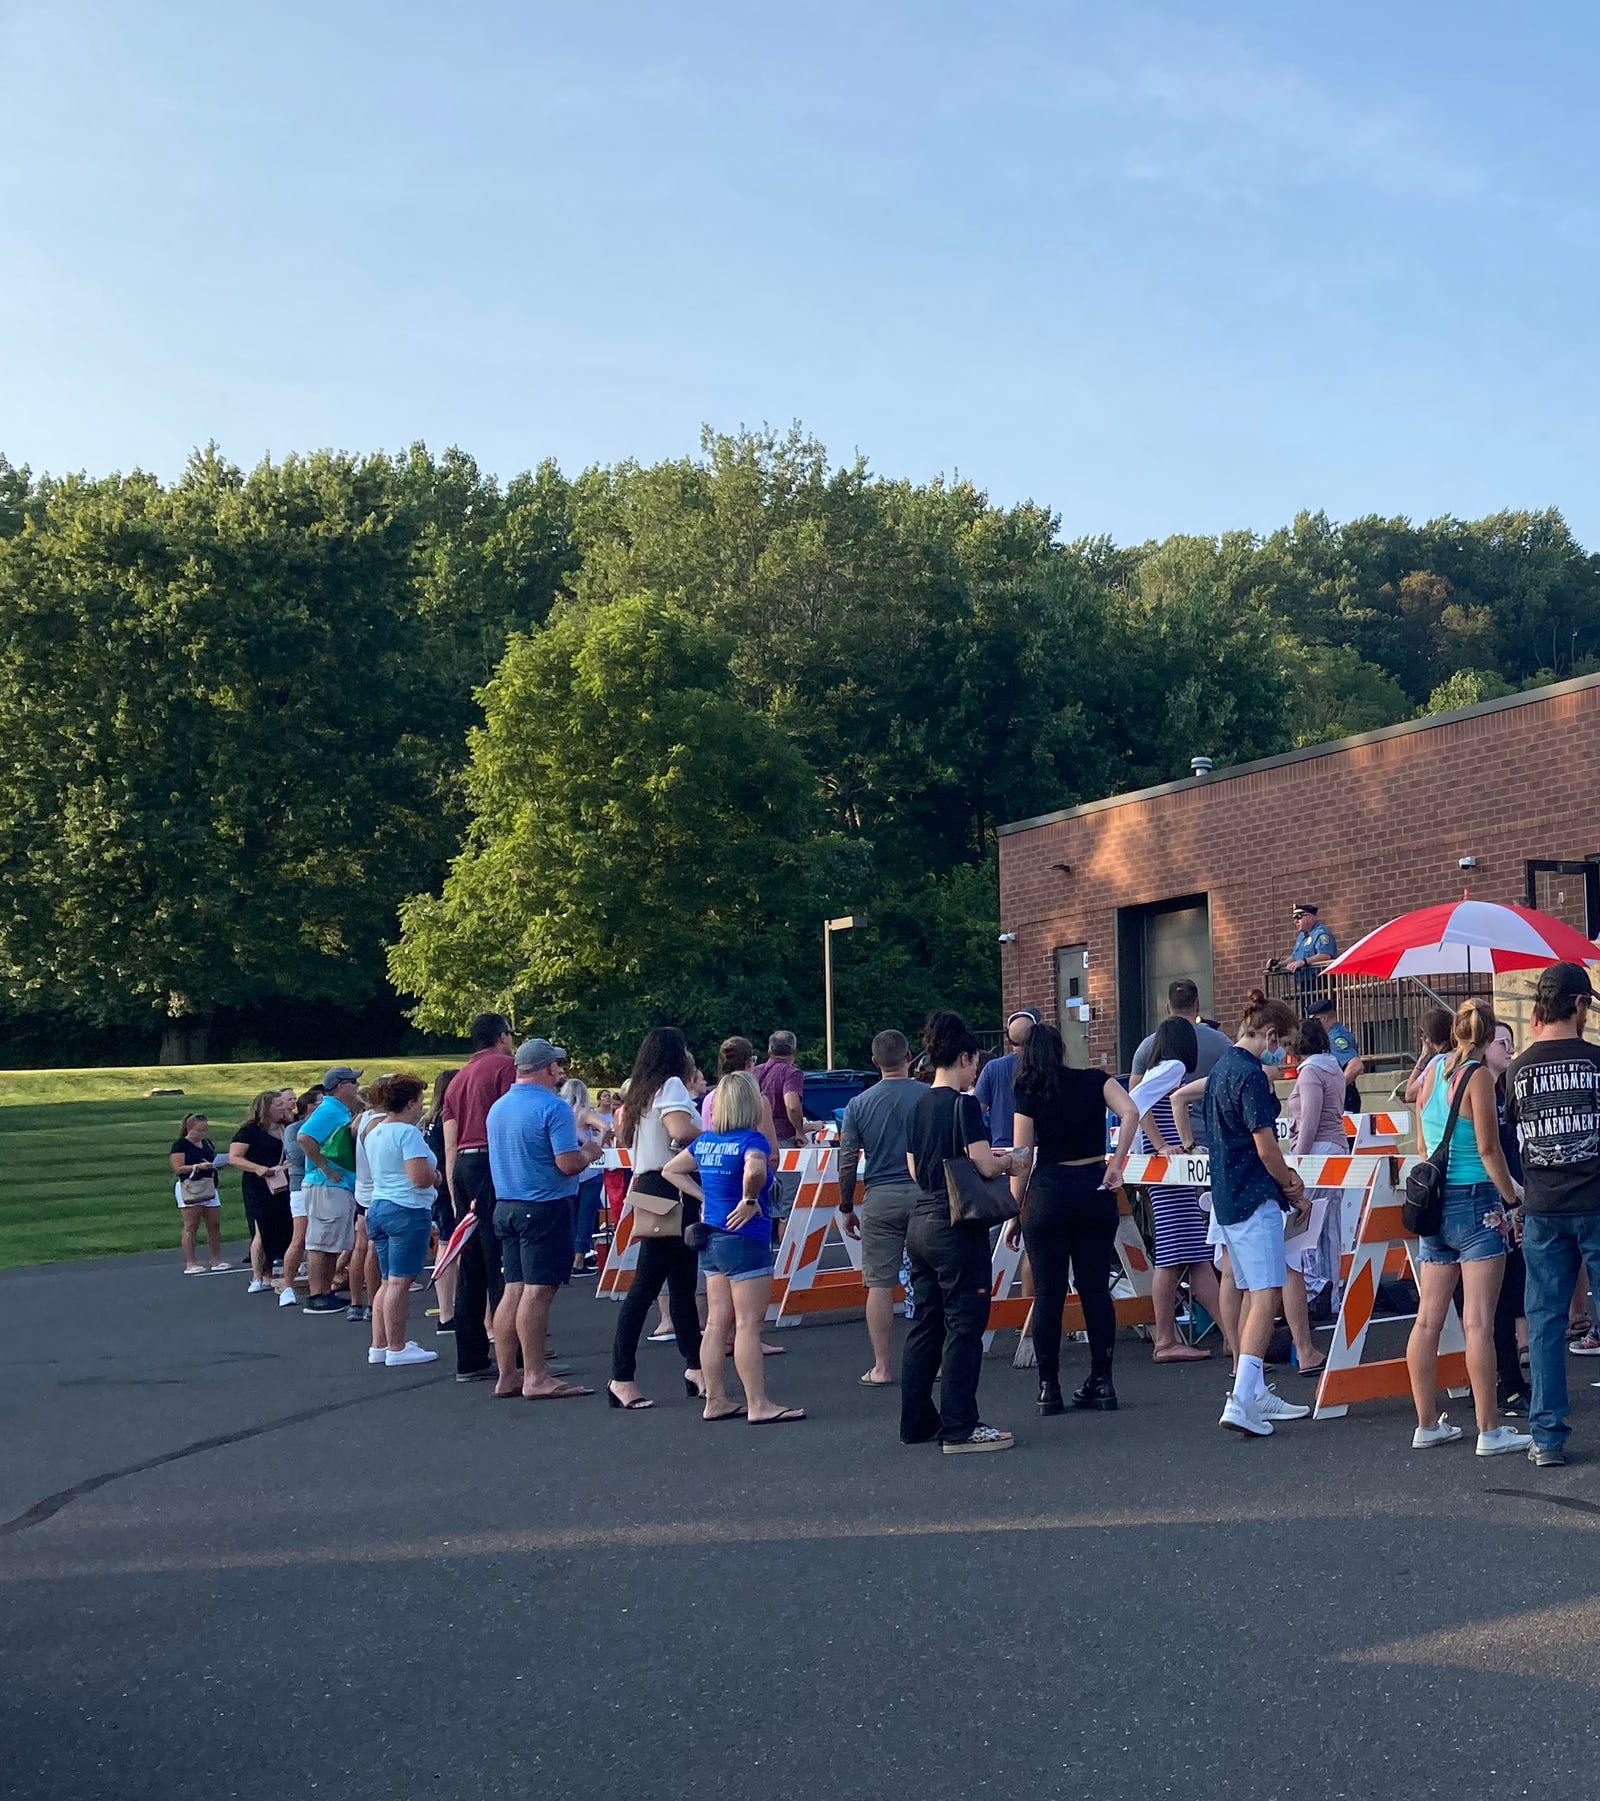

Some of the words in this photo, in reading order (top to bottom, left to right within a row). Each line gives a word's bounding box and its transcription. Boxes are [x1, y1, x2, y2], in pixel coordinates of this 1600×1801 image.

[1535, 1064, 1566, 1076] PROTECT
[1568, 1063, 1580, 1072] MY
[1513, 1078, 1528, 1100] 1ST
[1532, 1071, 1600, 1095] AMENDMENT
[1539, 1107, 1557, 1118] WITH
[1560, 1106, 1574, 1116] THE
[1187, 1159, 1211, 1183] ROA
